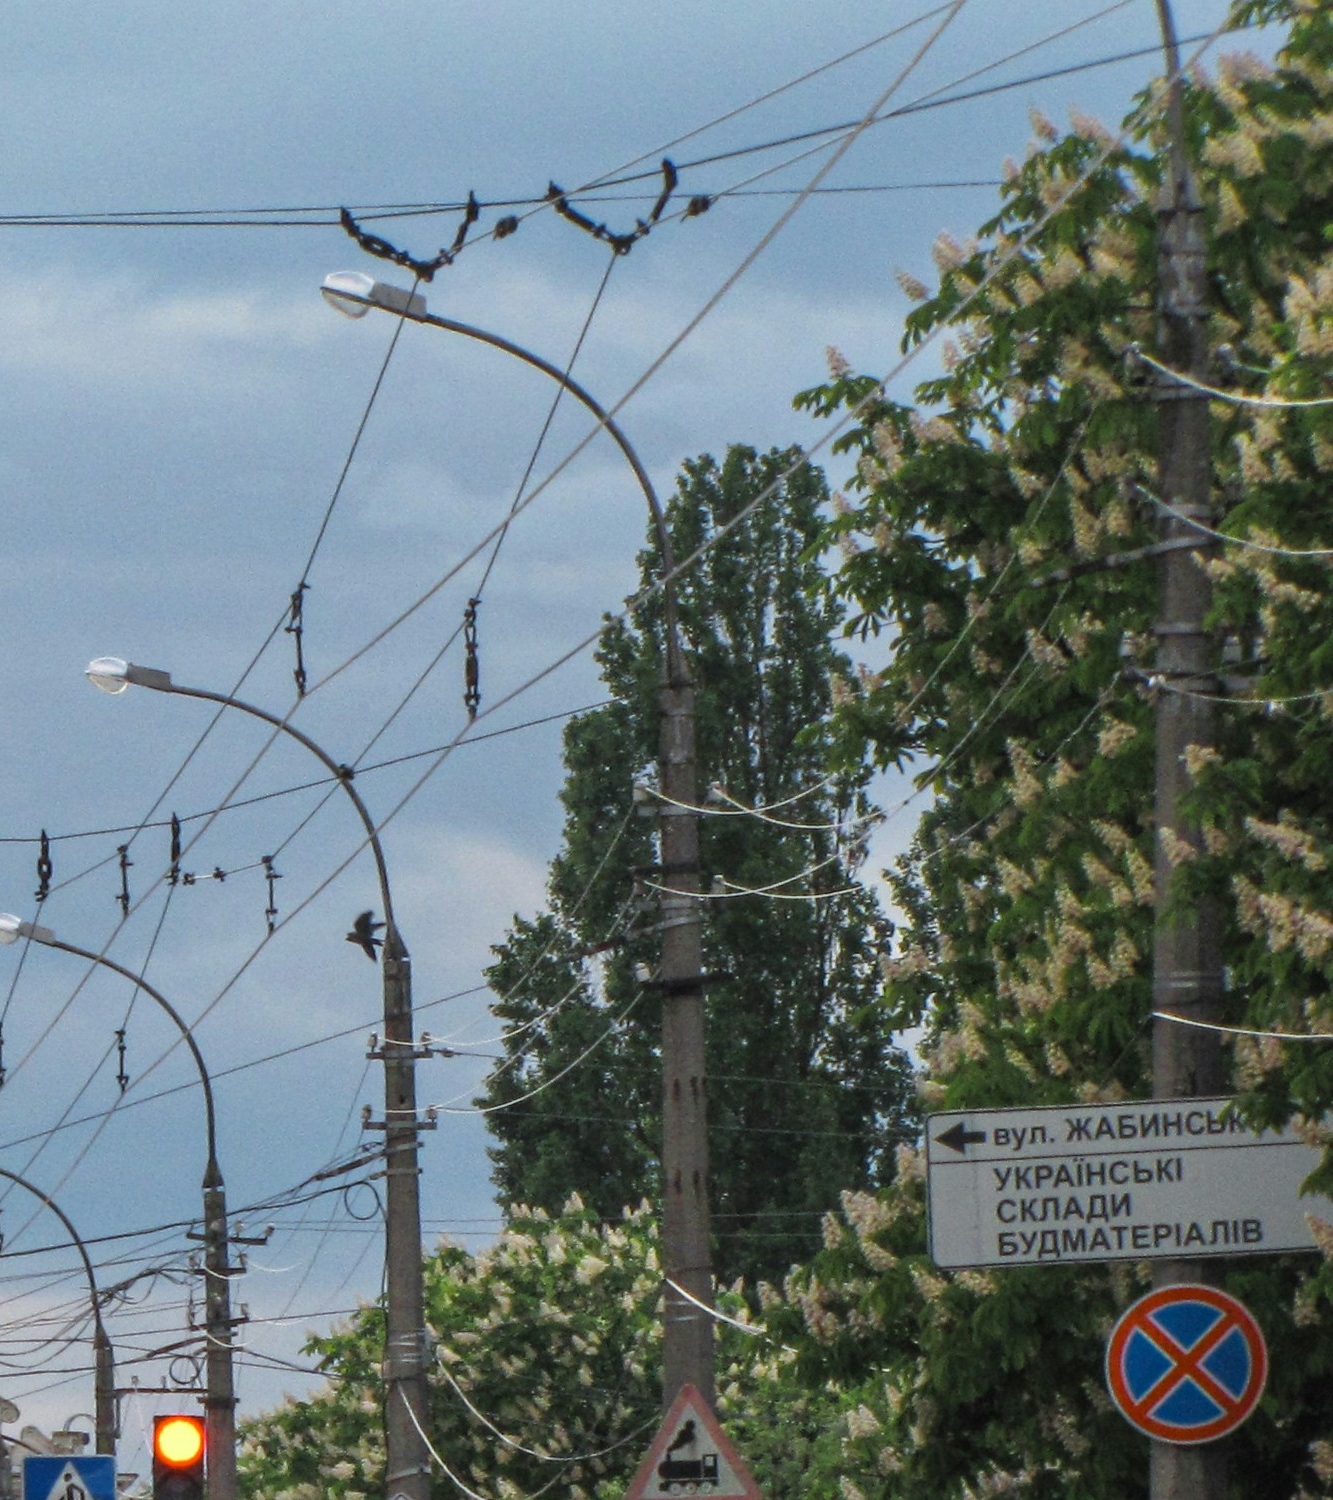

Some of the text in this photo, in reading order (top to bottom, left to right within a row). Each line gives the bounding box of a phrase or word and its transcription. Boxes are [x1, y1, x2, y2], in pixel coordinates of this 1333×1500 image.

[993, 1110, 1244, 1152] вул. ЖАБИНСЬК
[993, 1156, 1183, 1193] УКРАЇНСЬКІ
[996, 1192, 1132, 1224] СКЛАДИ
[997, 1219, 1264, 1259] БУДМАТЕРІАЛІВ
